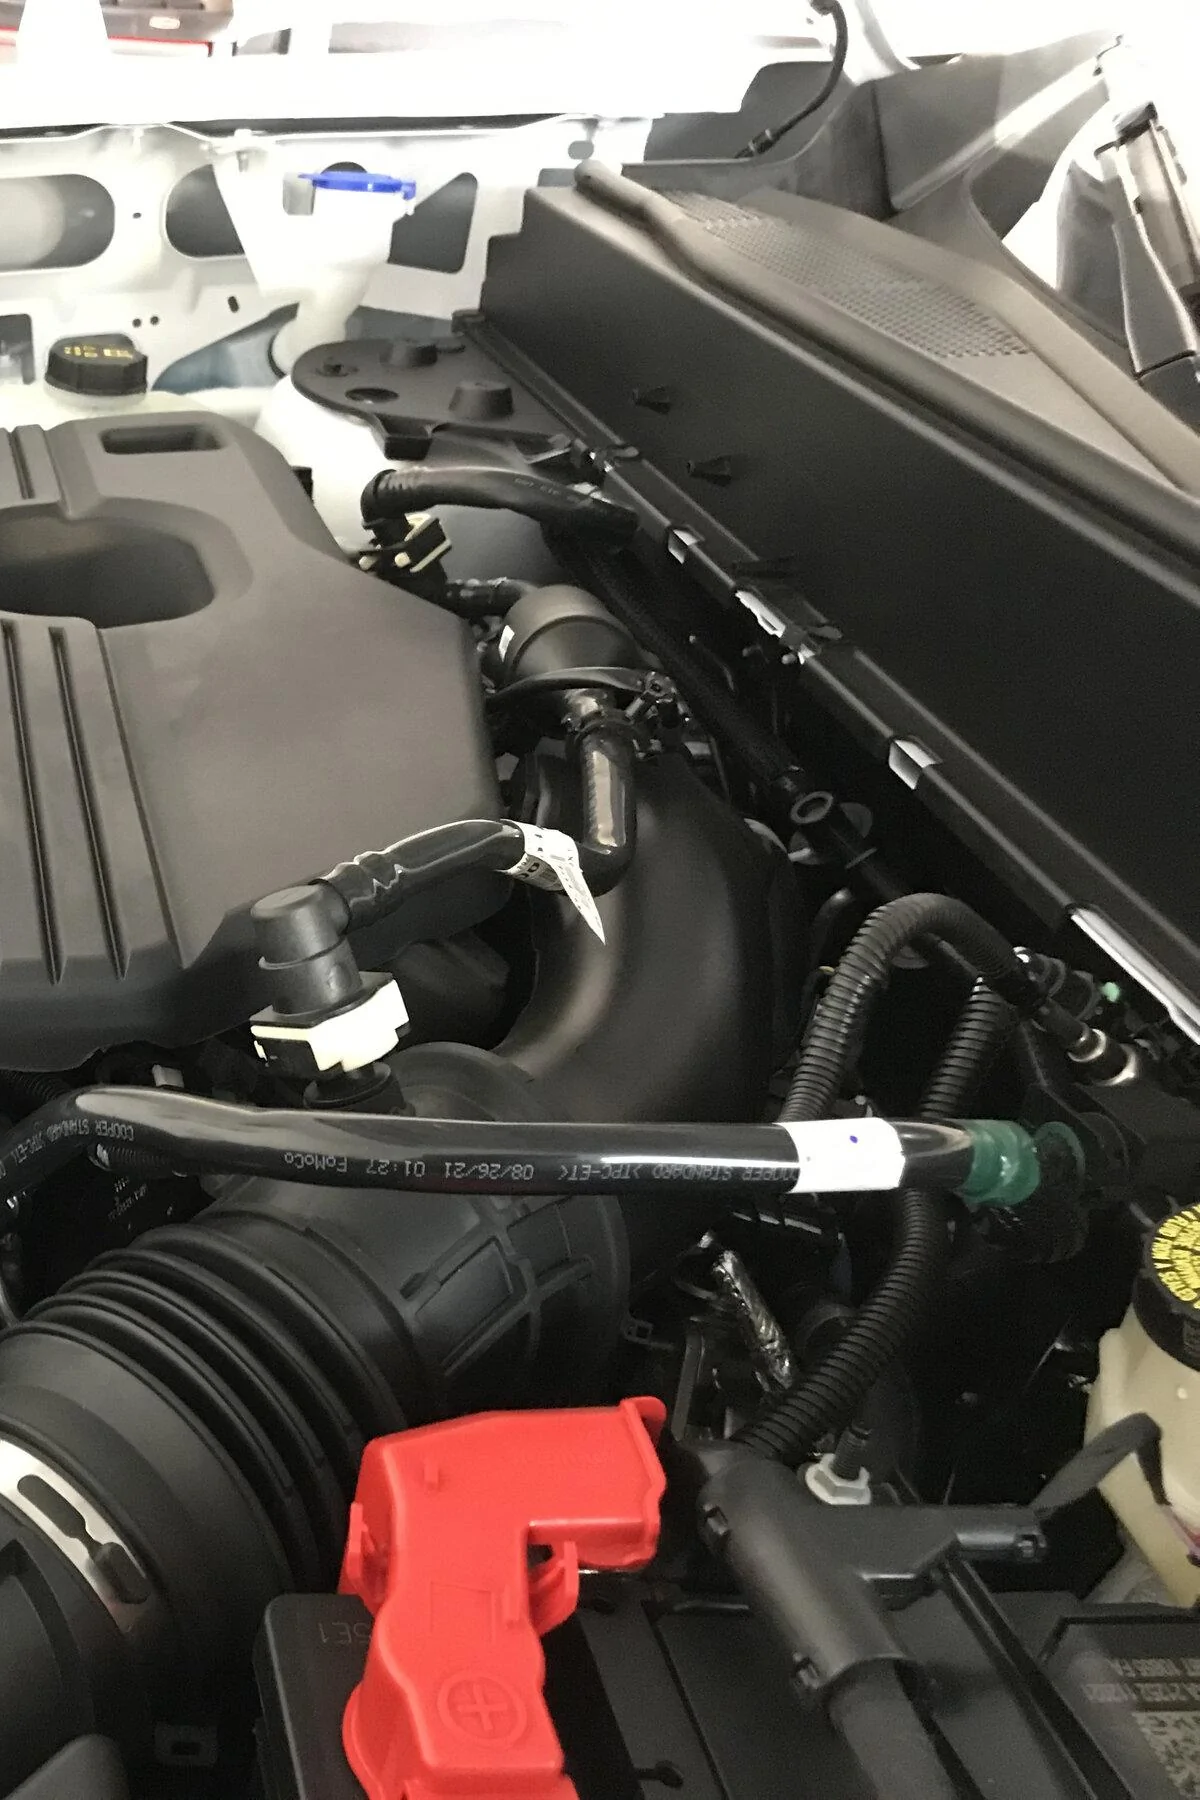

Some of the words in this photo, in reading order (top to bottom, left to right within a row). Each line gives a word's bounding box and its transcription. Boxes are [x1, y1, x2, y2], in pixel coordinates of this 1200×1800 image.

[95, 1119, 135, 1142] COOPER
[284, 1151, 348, 1173] FoMoCo
[366, 1158, 426, 1177] 01:27
[445, 1161, 535, 1181] 08/26/21
[651, 1163, 733, 1180] STANDARD
